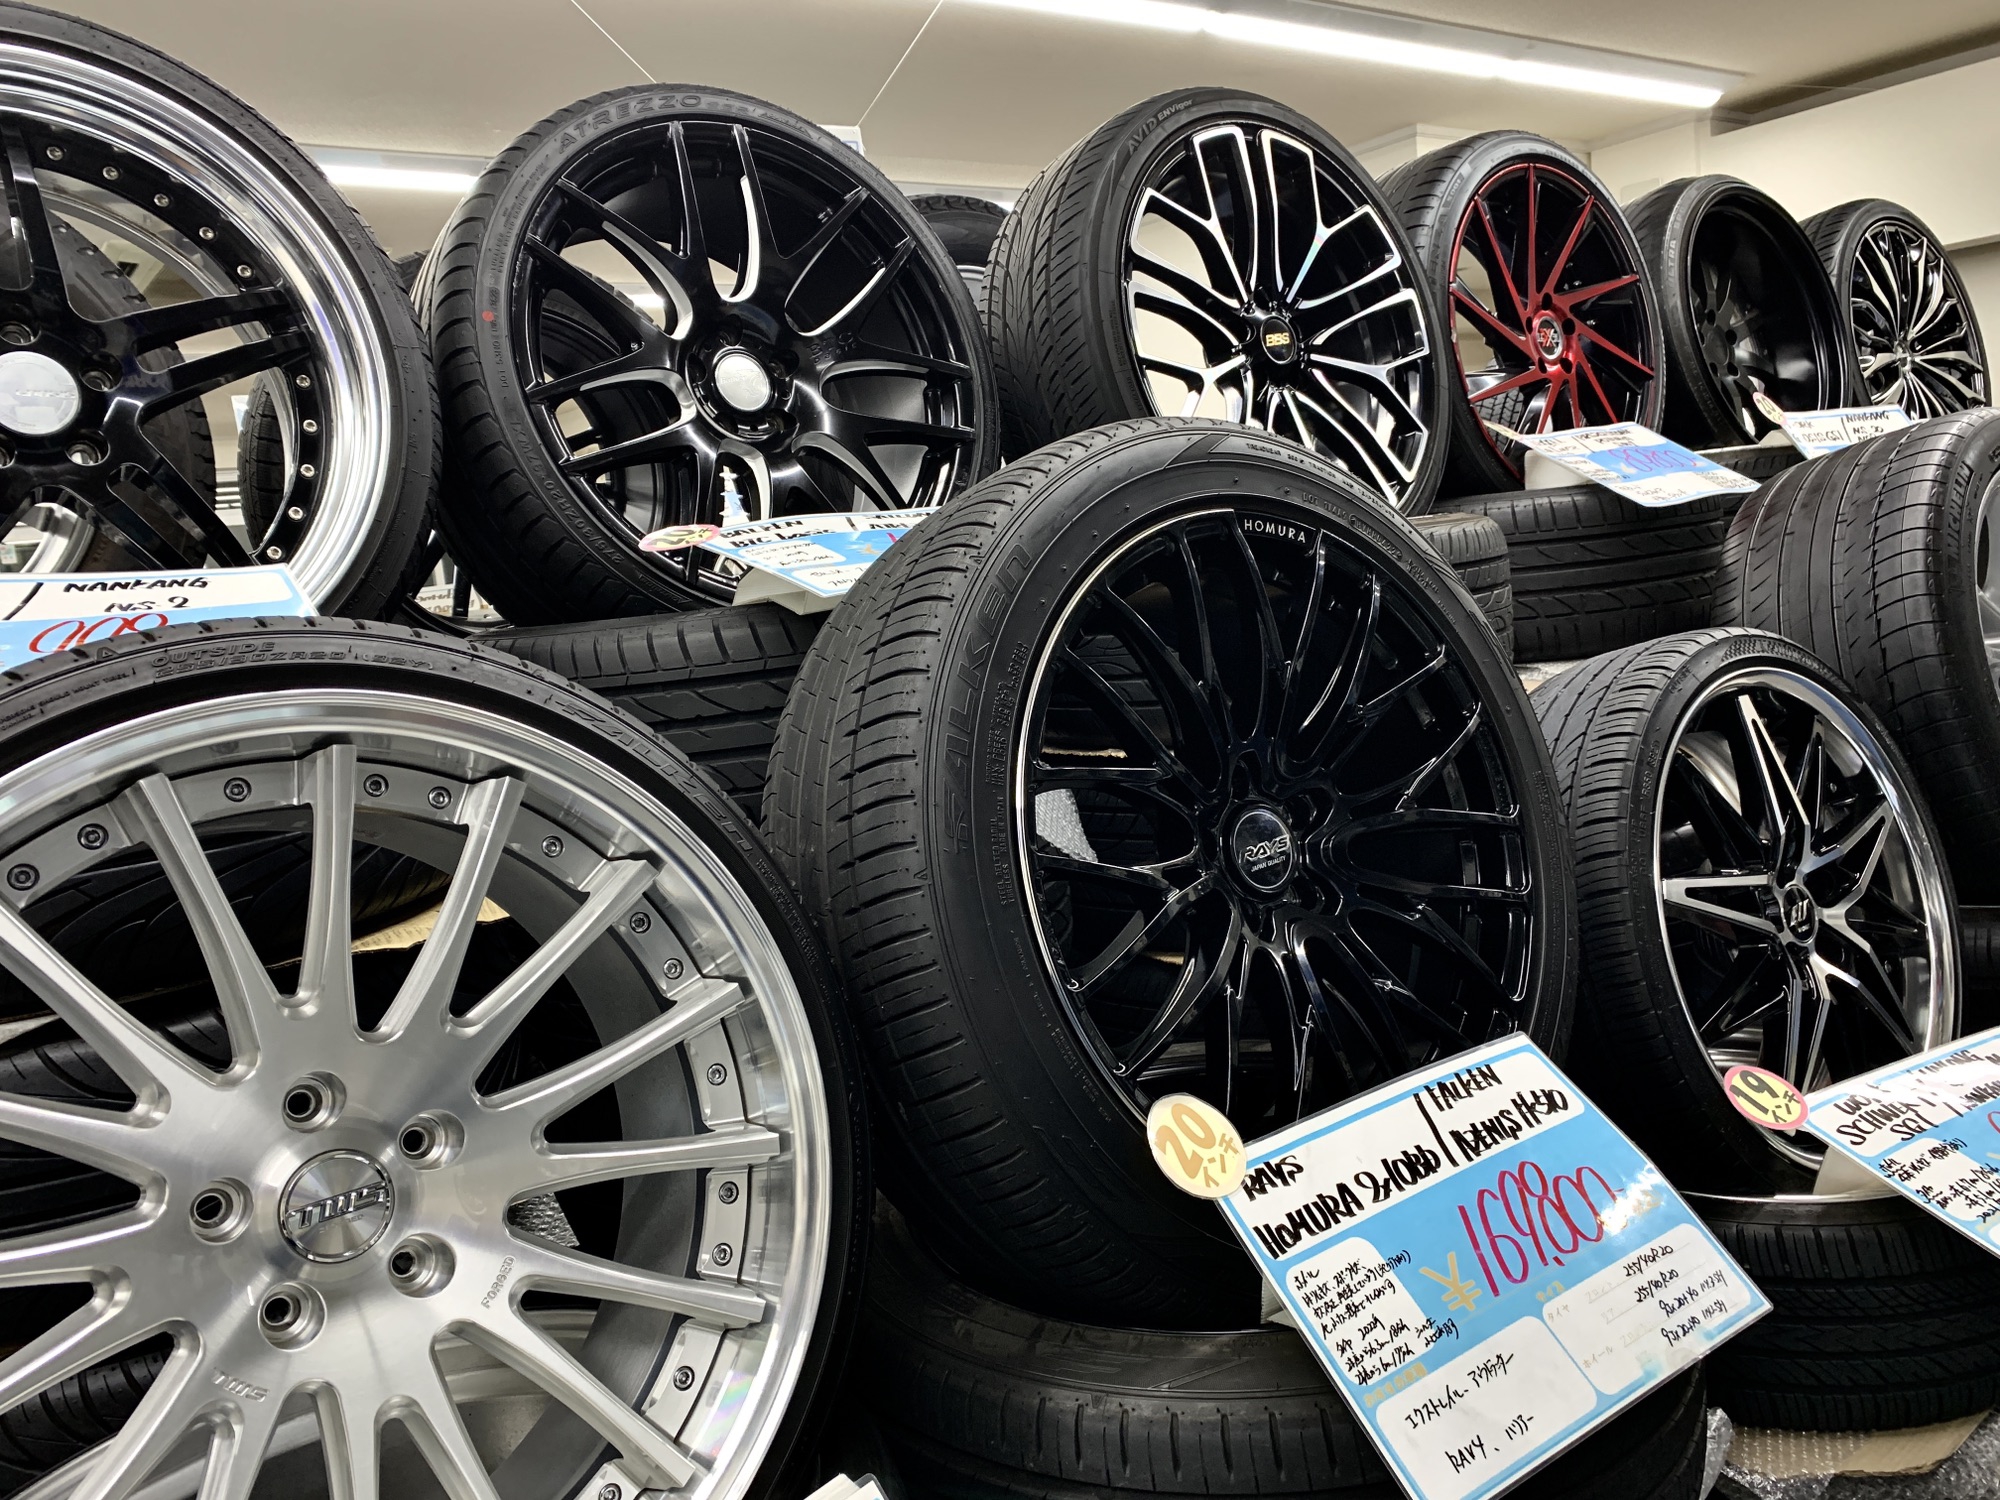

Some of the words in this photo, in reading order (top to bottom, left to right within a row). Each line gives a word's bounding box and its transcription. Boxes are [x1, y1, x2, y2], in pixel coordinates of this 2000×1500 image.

[556, 93, 702, 155] ATREZZO
[1127, 117, 1158, 155] AVID
[1157, 99, 1194, 122] ENVigor
[1265, 332, 1290, 347] BBS
[1244, 518, 1306, 544] HOMURA
[1948, 459, 1975, 560] MICHELIN
[151, 641, 277, 669] OUTSIDE
[154, 650, 347, 680] 255/30ZR20
[1243, 833, 1290, 863] RAYS
[1250, 862, 1268, 873] JAPAN
[1267, 854, 1287, 868] QUALITY
[1423, 1063, 1503, 1113] FALKEN
[1729, 1069, 1780, 1116] 19
[1770, 1089, 1802, 1125] インチ
[1155, 1102, 1217, 1180] 20
[1202, 1132, 1240, 1189] インチ
[1242, 1154, 1305, 1202] RAYS
[1252, 1182, 1366, 1261] HOMURA
[479, 1254, 518, 1311] FORGED
